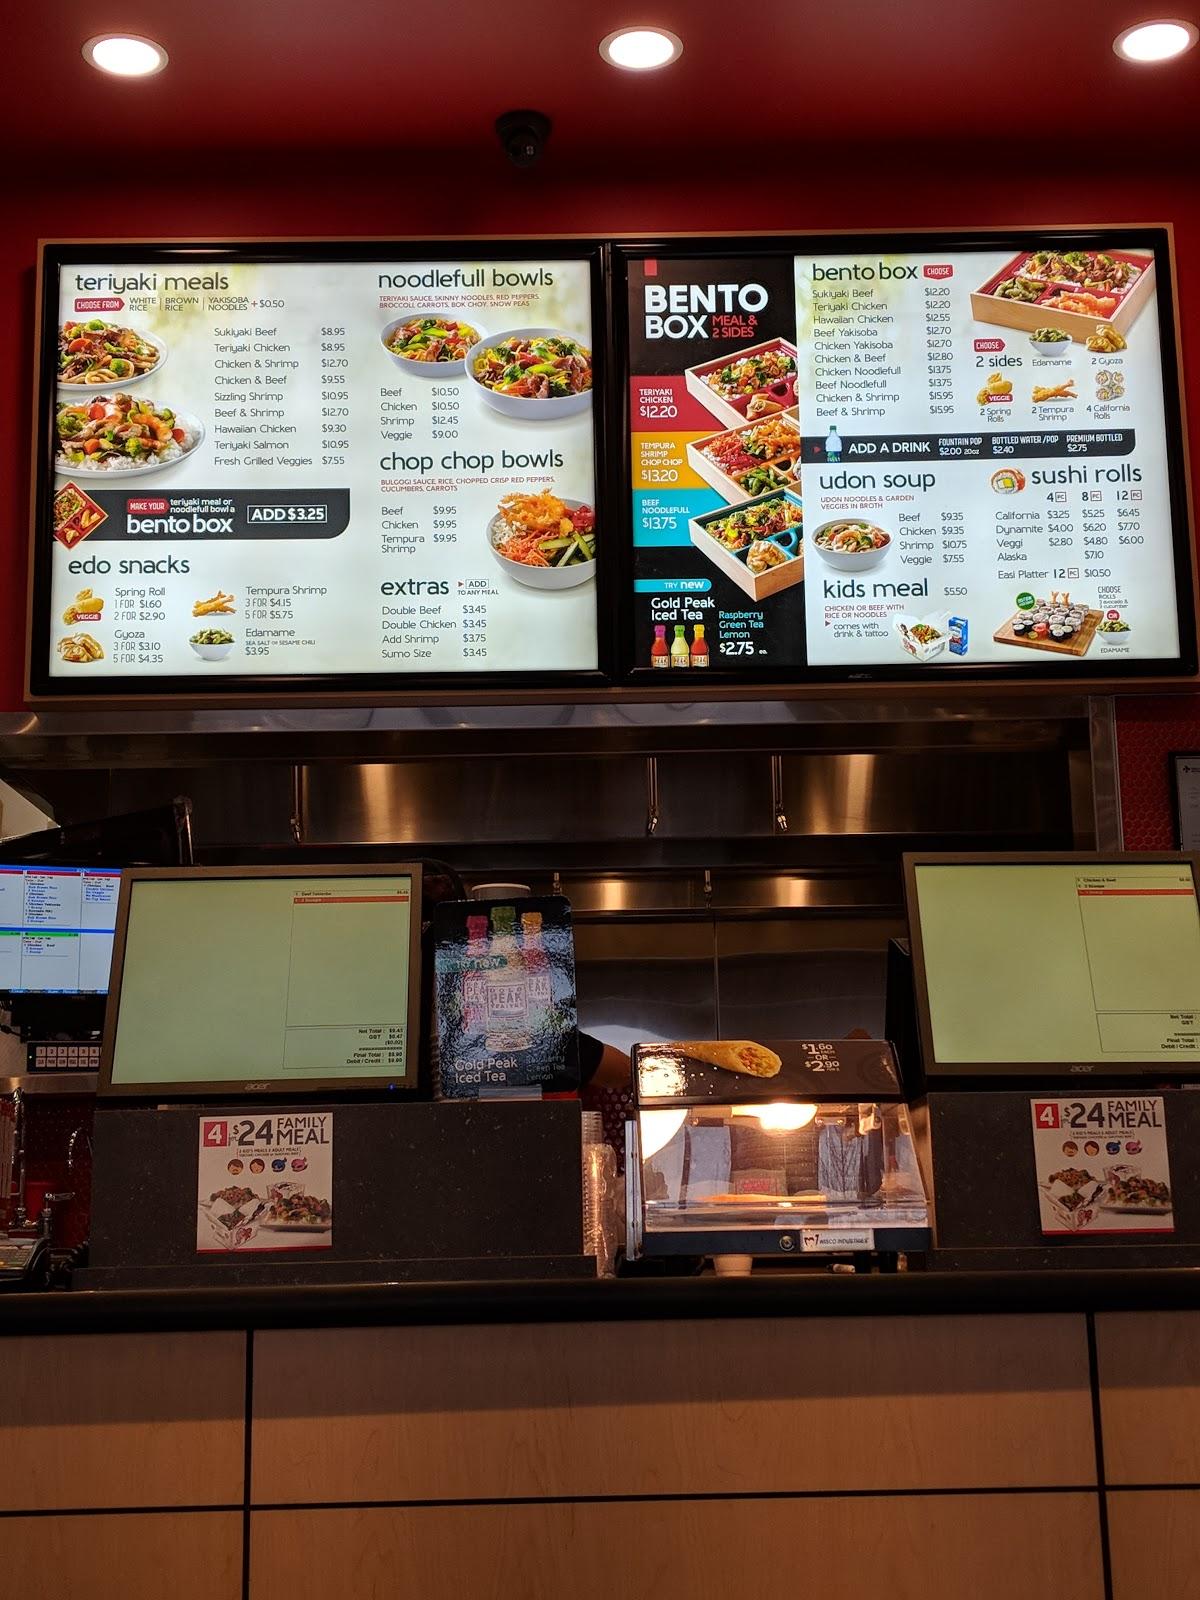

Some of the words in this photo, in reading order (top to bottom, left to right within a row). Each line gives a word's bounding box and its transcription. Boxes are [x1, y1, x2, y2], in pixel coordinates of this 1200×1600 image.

[812, 264, 875, 281] bento
[879, 262, 918, 279] box
[927, 267, 950, 276] CHOOSE
[75, 273, 156, 294] teriyaki
[165, 272, 229, 290] meals
[379, 269, 484, 288] noodlefull
[493, 268, 553, 286] bowls
[164, 296, 199, 305] BROWN
[208, 296, 249, 305] YAKISOBA
[644, 283, 769, 313] BENTO
[76, 300, 100, 310] CHOOSE
[101, 300, 120, 310] FROM
[128, 304, 147, 312] RICE
[165, 304, 183, 312] RICE
[207, 303, 248, 312] NOODLES
[713, 314, 746, 326] MEAL
[747, 315, 758, 326] &
[214, 328, 252, 337] Sukiyaki
[255, 328, 277, 336] Beef
[321, 327, 345, 336] $8.95
[645, 314, 709, 339] BOX
[712, 326, 720, 338] 2
[721, 326, 755, 338] SIDES
[815, 342, 850, 351] Chicken
[854, 341, 893, 350] Yakisoba
[927, 339, 952, 348] $12.70
[976, 356, 984, 367] 2
[989, 355, 1022, 367] sides
[639, 388, 673, 396] TERIYAKI
[639, 395, 674, 404] CHICKEN
[380, 402, 417, 411] Chicken
[432, 402, 459, 410] $10.50
[639, 405, 677, 419] $12.20
[1094, 404, 1130, 413] California
[1093, 412, 1110, 420] Rolls
[214, 425, 256, 433] Hawaiian
[260, 424, 296, 433] Chicken
[322, 424, 346, 432] $9.30
[381, 431, 412, 441] Veggie
[432, 430, 458, 439] $9.00
[1066, 433, 1094, 443] PREMIUM
[1095, 433, 1123, 443] BOTTLED
[849, 443, 876, 453] ADD
[880, 443, 889, 453] A
[893, 441, 930, 452] DRINK
[938, 447, 962, 456] $2.00
[1066, 443, 1088, 452] $2.75
[215, 457, 240, 465] Fresh
[244, 457, 273, 465] Grilled
[277, 457, 312, 467] Veggies
[322, 456, 344, 464] $7.55
[380, 452, 433, 474] chop
[441, 451, 494, 473] chop
[502, 449, 563, 468] bowls
[640, 458, 661, 466] CHOP
[661, 458, 684, 466] CHOP
[641, 469, 679, 483] $13.20
[1032, 465, 1087, 484] sushi
[1095, 464, 1142, 482] rolls
[820, 471, 875, 489] udon
[884, 474, 935, 492] soup
[130, 501, 165, 511] YOUR
[170, 497, 200, 507] teriyaki
[201, 498, 221, 507] meal
[222, 498, 233, 507] or
[641, 499, 660, 507] BEEF
[251, 509, 286, 521] ADD
[288, 509, 324, 521] $3.25
[642, 506, 691, 515] NOODLEFULL
[995, 512, 1040, 521] California
[1047, 510, 1070, 519] $3.25
[1082, 509, 1104, 518] $5.25
[1116, 508, 1140, 518] $6.45
[899, 513, 920, 521] Beef
[941, 512, 963, 521] $9.35
[126, 514, 190, 534] bento
[192, 514, 233, 533] box
[642, 516, 677, 530] $13.75
[996, 525, 1043, 535] Dynamite
[1048, 524, 1073, 532] $4.00
[1083, 523, 1106, 532] $6.20
[1117, 521, 1140, 531] $7.70
[68, 555, 111, 574] edo
[119, 555, 190, 574] snacks
[998, 571, 1015, 579] Easi
[1018, 569, 1049, 578] Platter
[1054, 569, 1065, 578] 12
[1084, 568, 1111, 577] $10.50
[381, 579, 449, 595] extras
[469, 580, 487, 588] ADD
[680, 581, 705, 589] new
[824, 579, 865, 598] kids
[873, 578, 928, 597] meal
[944, 587, 967, 596] $5.50
[115, 588, 145, 598] Spring
[149, 587, 165, 596] Roll
[246, 586, 290, 596] Tempura
[293, 586, 327, 596] Shrimp
[1097, 585, 1121, 595] CHOOSE
[651, 598, 680, 608] Gold
[685, 597, 715, 608] Peak
[76, 613, 99, 621] VEGGIE
[114, 612, 119, 620] 2
[122, 611, 136, 620] FOR
[139, 612, 165, 621] $2.90
[652, 609, 677, 620] Iced
[681, 609, 703, 620] Tea
[719, 611, 763, 621] Raspberry
[748, 620, 763, 628] Tea
[862, 622, 879, 631] with
[246, 628, 295, 637] Edamame
[833, 629, 854, 638] drink
[856, 629, 862, 638] &
[865, 629, 888, 637] tattoo
[382, 635, 401, 643] Add
[405, 635, 439, 645] Shrimp
[463, 633, 486, 643] $3.75
[245, 646, 269, 655] $3.95
[720, 642, 754, 655] $2.75
[491, 991, 522, 1005] PEAK
[802, 1043, 834, 1055] $1.60
[454, 1057, 485, 1072] Gold
[485, 1057, 518, 1072] Peak
[805, 1060, 839, 1071] $2.90
[455, 1071, 481, 1084] Iced
[481, 1071, 507, 1083] Tea
[1040, 1106, 1054, 1126] 4
[1063, 1103, 1105, 1129] $24
[1108, 1100, 1157, 1112] FAMILY
[1108, 1111, 1162, 1129] MEAL
[207, 1123, 222, 1144] 4
[232, 1120, 273, 1147] $24
[277, 1117, 326, 1129] FAMILY
[277, 1128, 329, 1145] MEAL
